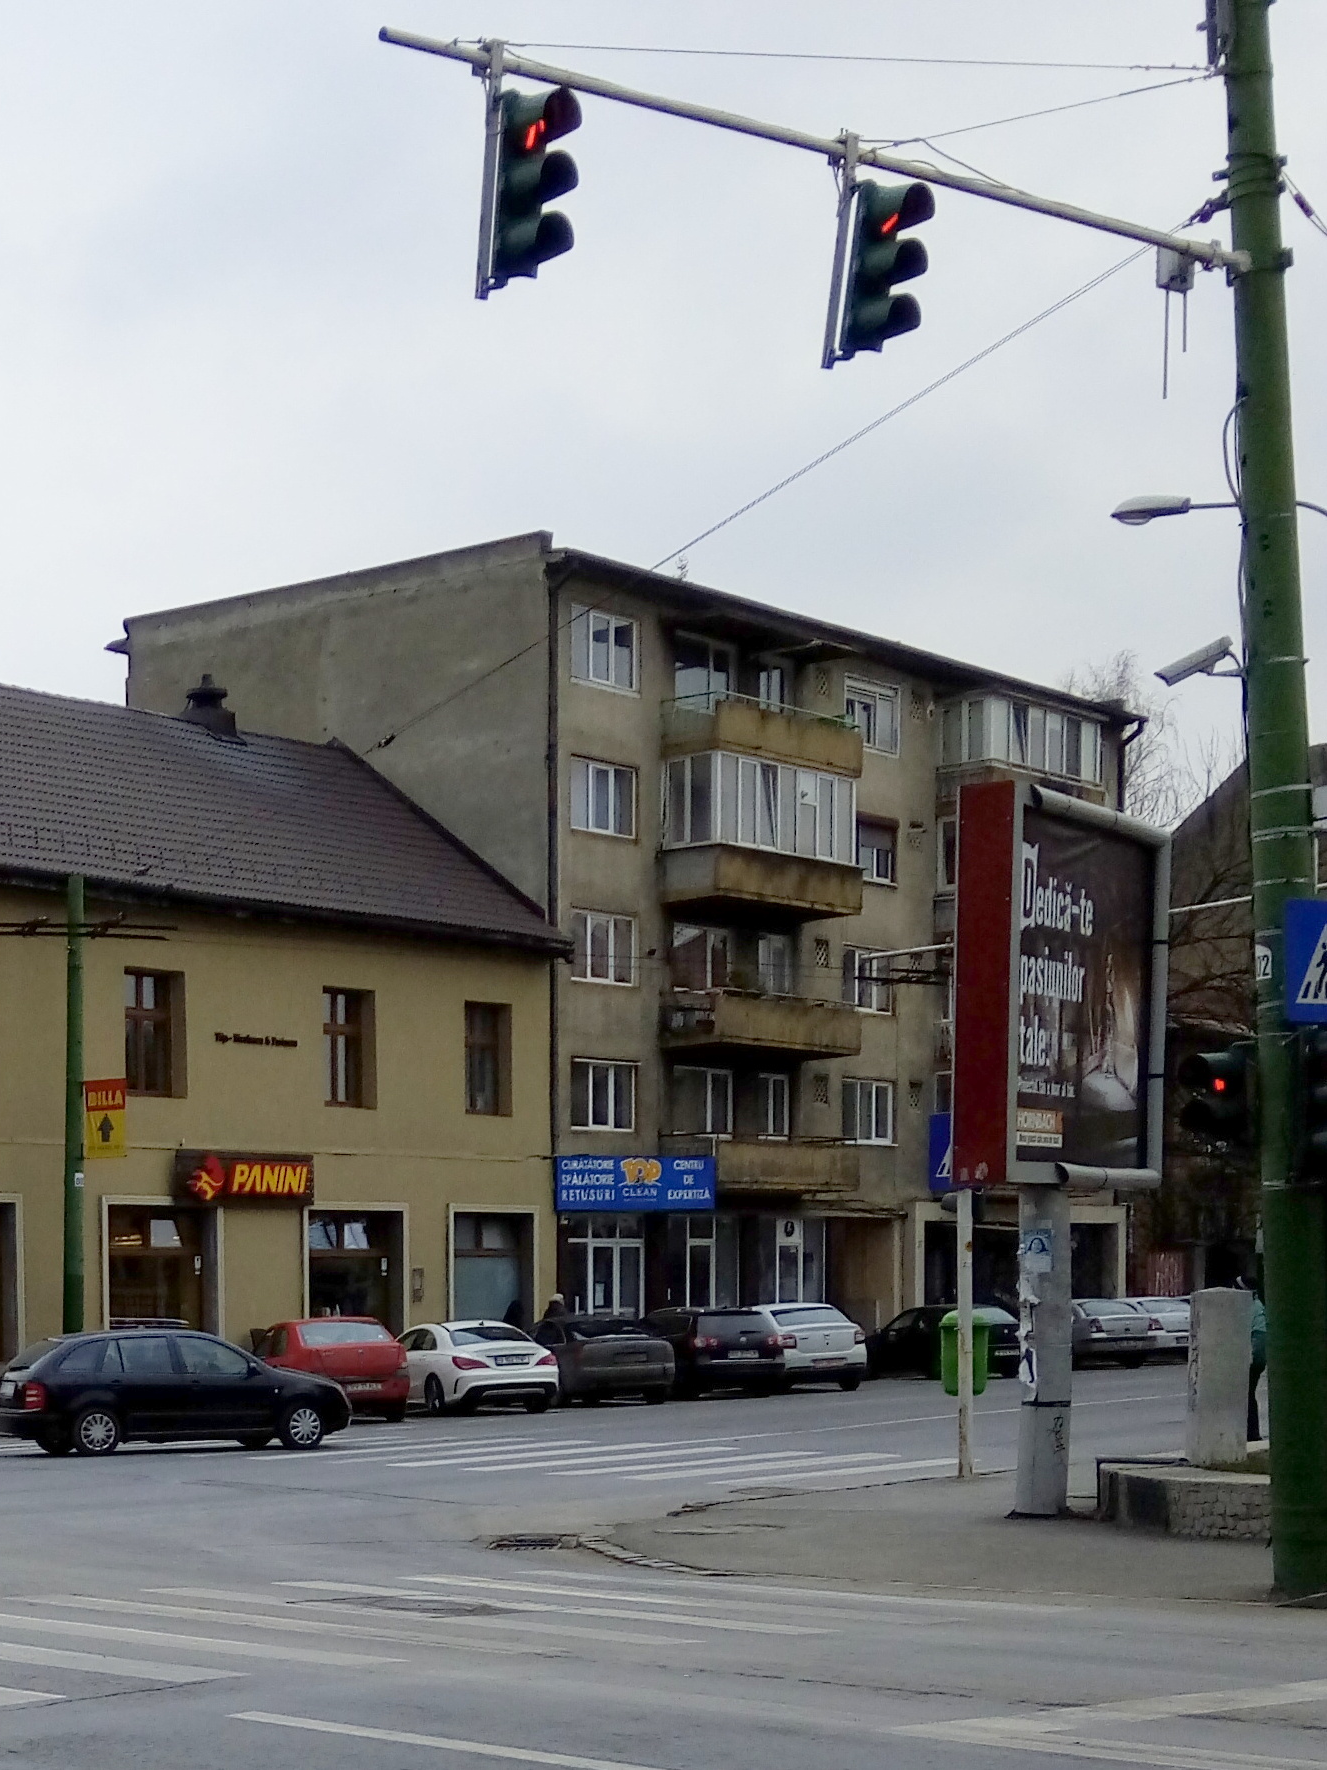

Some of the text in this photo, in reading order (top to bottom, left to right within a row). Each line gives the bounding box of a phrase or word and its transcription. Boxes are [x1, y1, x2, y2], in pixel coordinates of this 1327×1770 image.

[1019, 946, 1085, 1005] pasiunilor
[87, 1089, 124, 1107] BILLA
[673, 1159, 705, 1171] CENTRU
[232, 1164, 307, 1192] PANINI
[683, 1174, 694, 1185] DE
[623, 1188, 657, 1196] CLEAN
